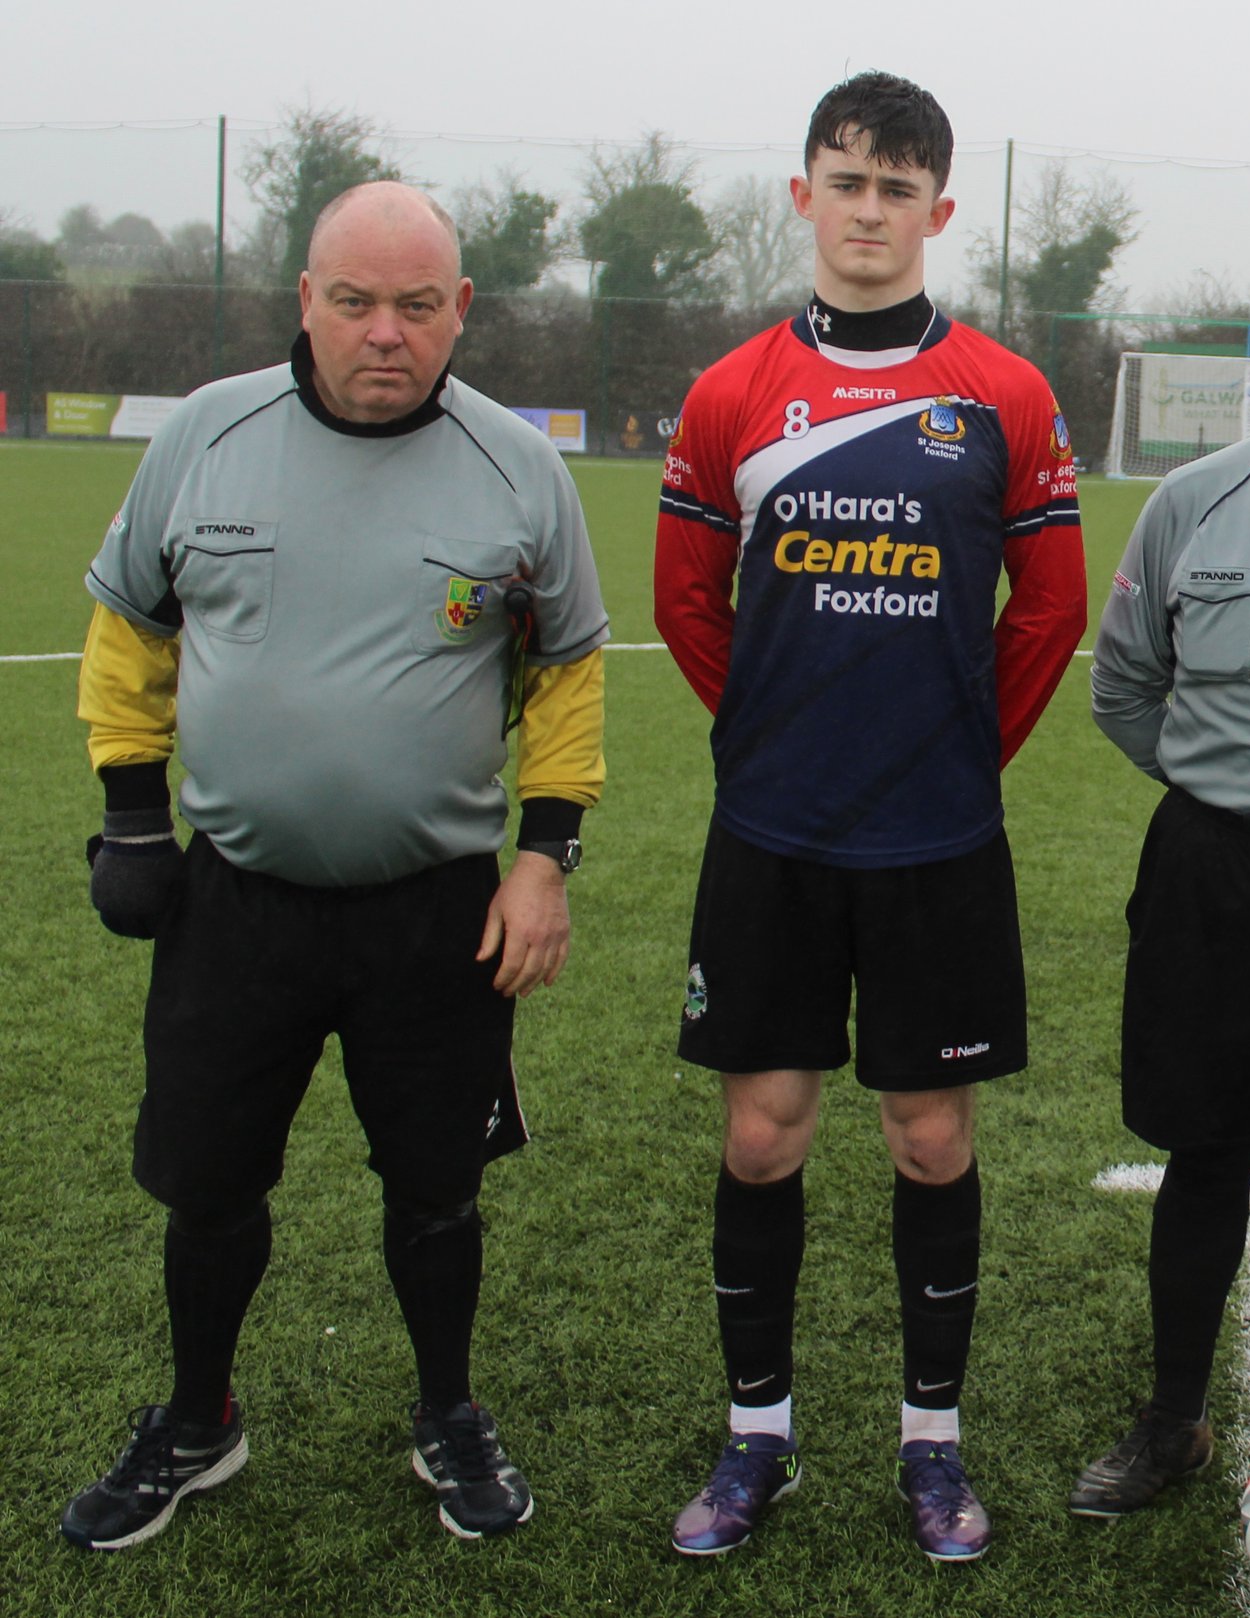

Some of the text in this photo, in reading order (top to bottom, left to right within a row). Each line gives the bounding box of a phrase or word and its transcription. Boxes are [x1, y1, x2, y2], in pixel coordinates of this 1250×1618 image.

[782, 399, 810, 440] 8
[917, 437, 966, 454] St Josephs
[925, 446, 958, 460] Foxford
[774, 491, 922, 523] O'Hara's
[195, 524, 255, 536] STANNO
[774, 530, 941, 579] Centra
[1190, 572, 1244, 580] STANNO
[815, 583, 939, 617] Foxford
